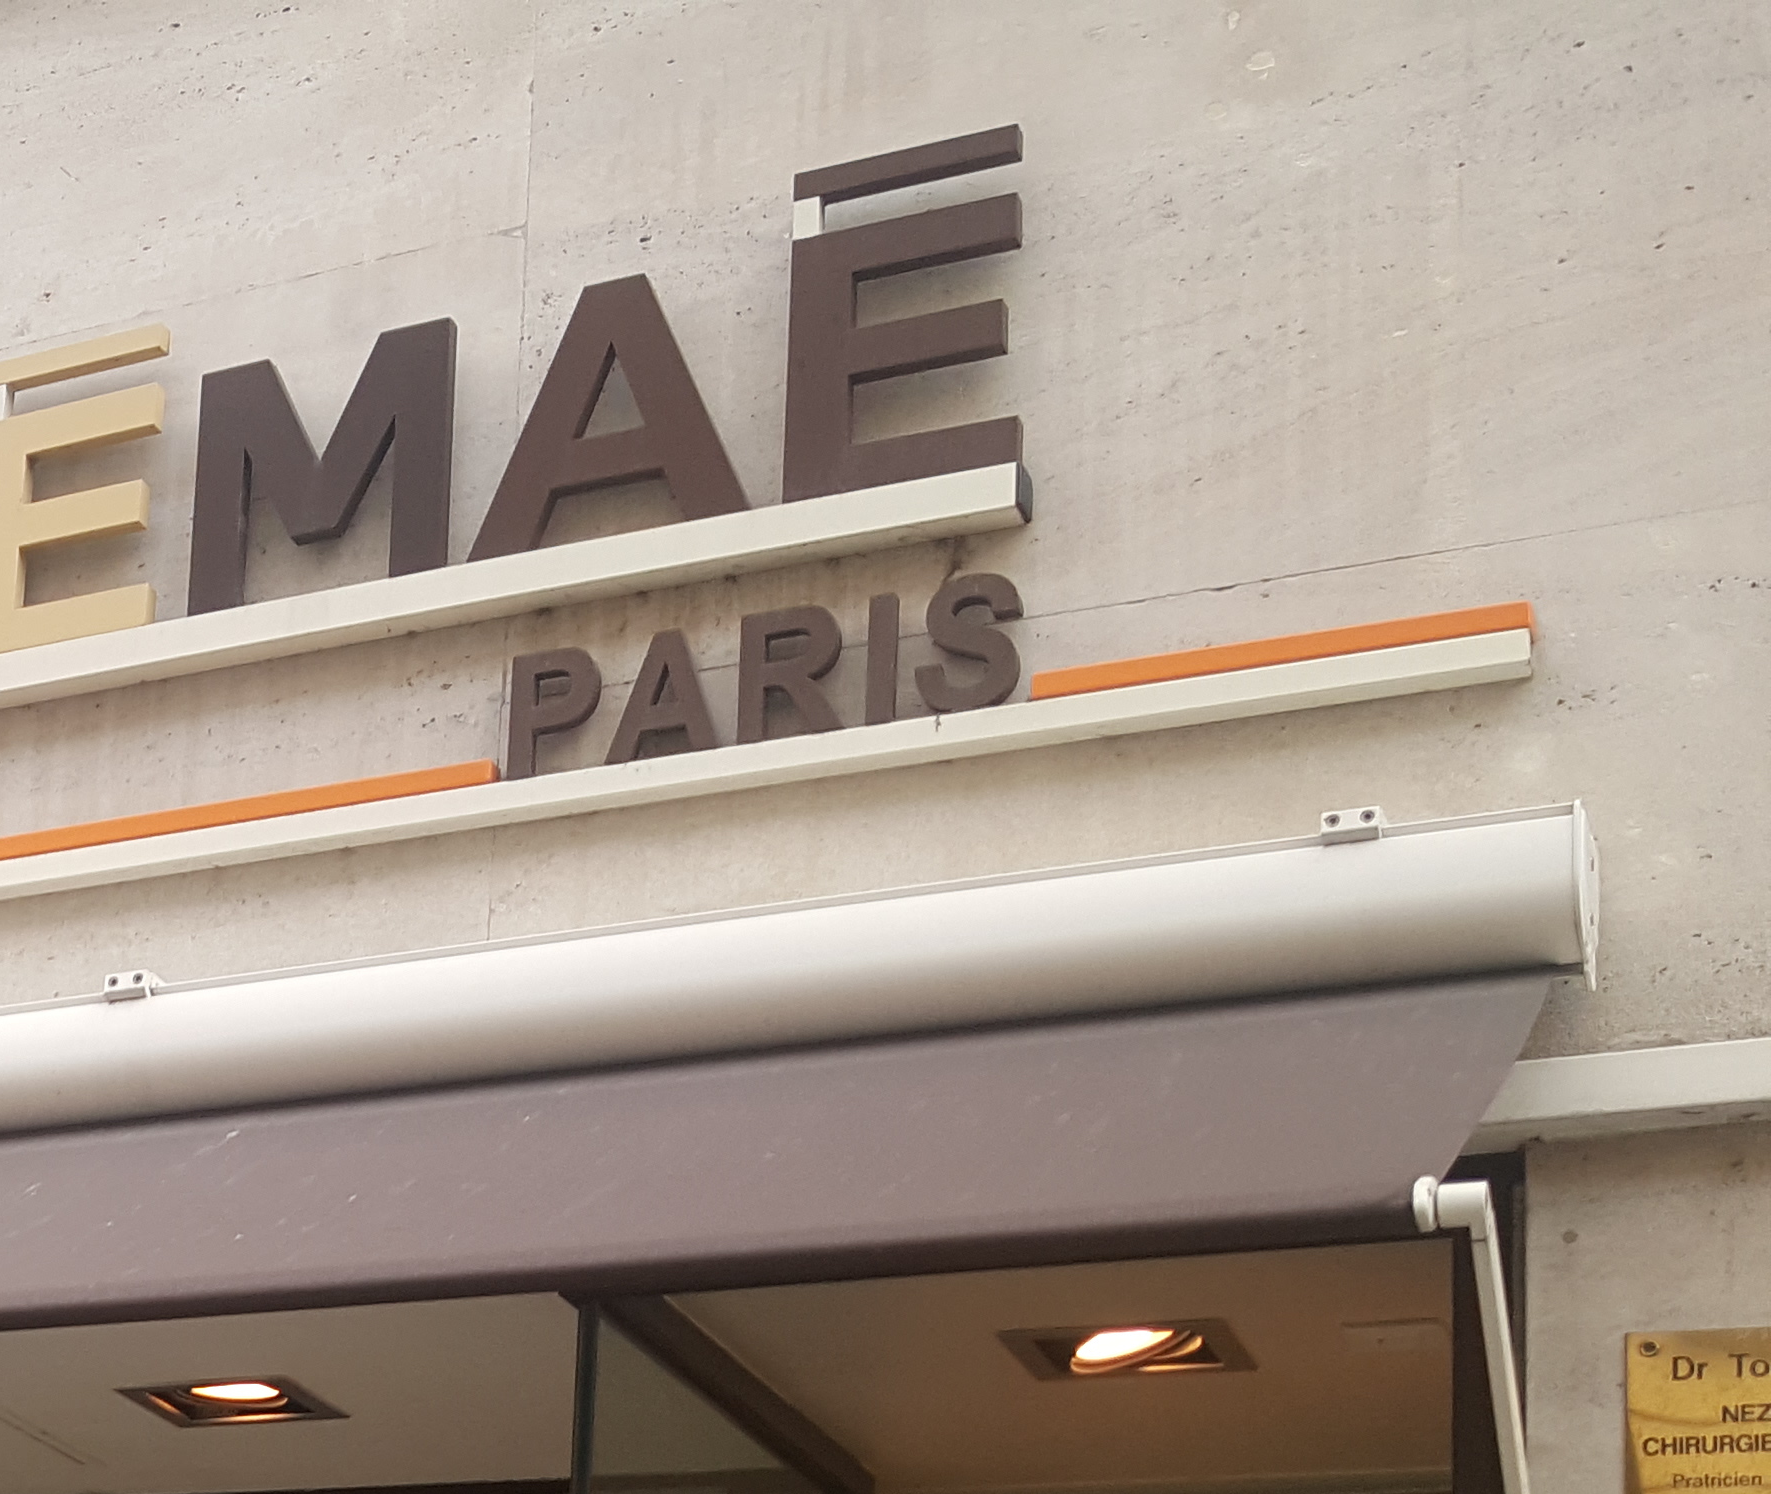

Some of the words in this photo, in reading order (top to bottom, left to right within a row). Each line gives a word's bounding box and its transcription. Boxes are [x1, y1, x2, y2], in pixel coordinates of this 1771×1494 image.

[506, 571, 1027, 779] PARIS
[1672, 1356, 1708, 1381] Dr
[1722, 1403, 1771, 1423] NEZ
[1643, 1434, 1771, 1457] CHIRURGIE
